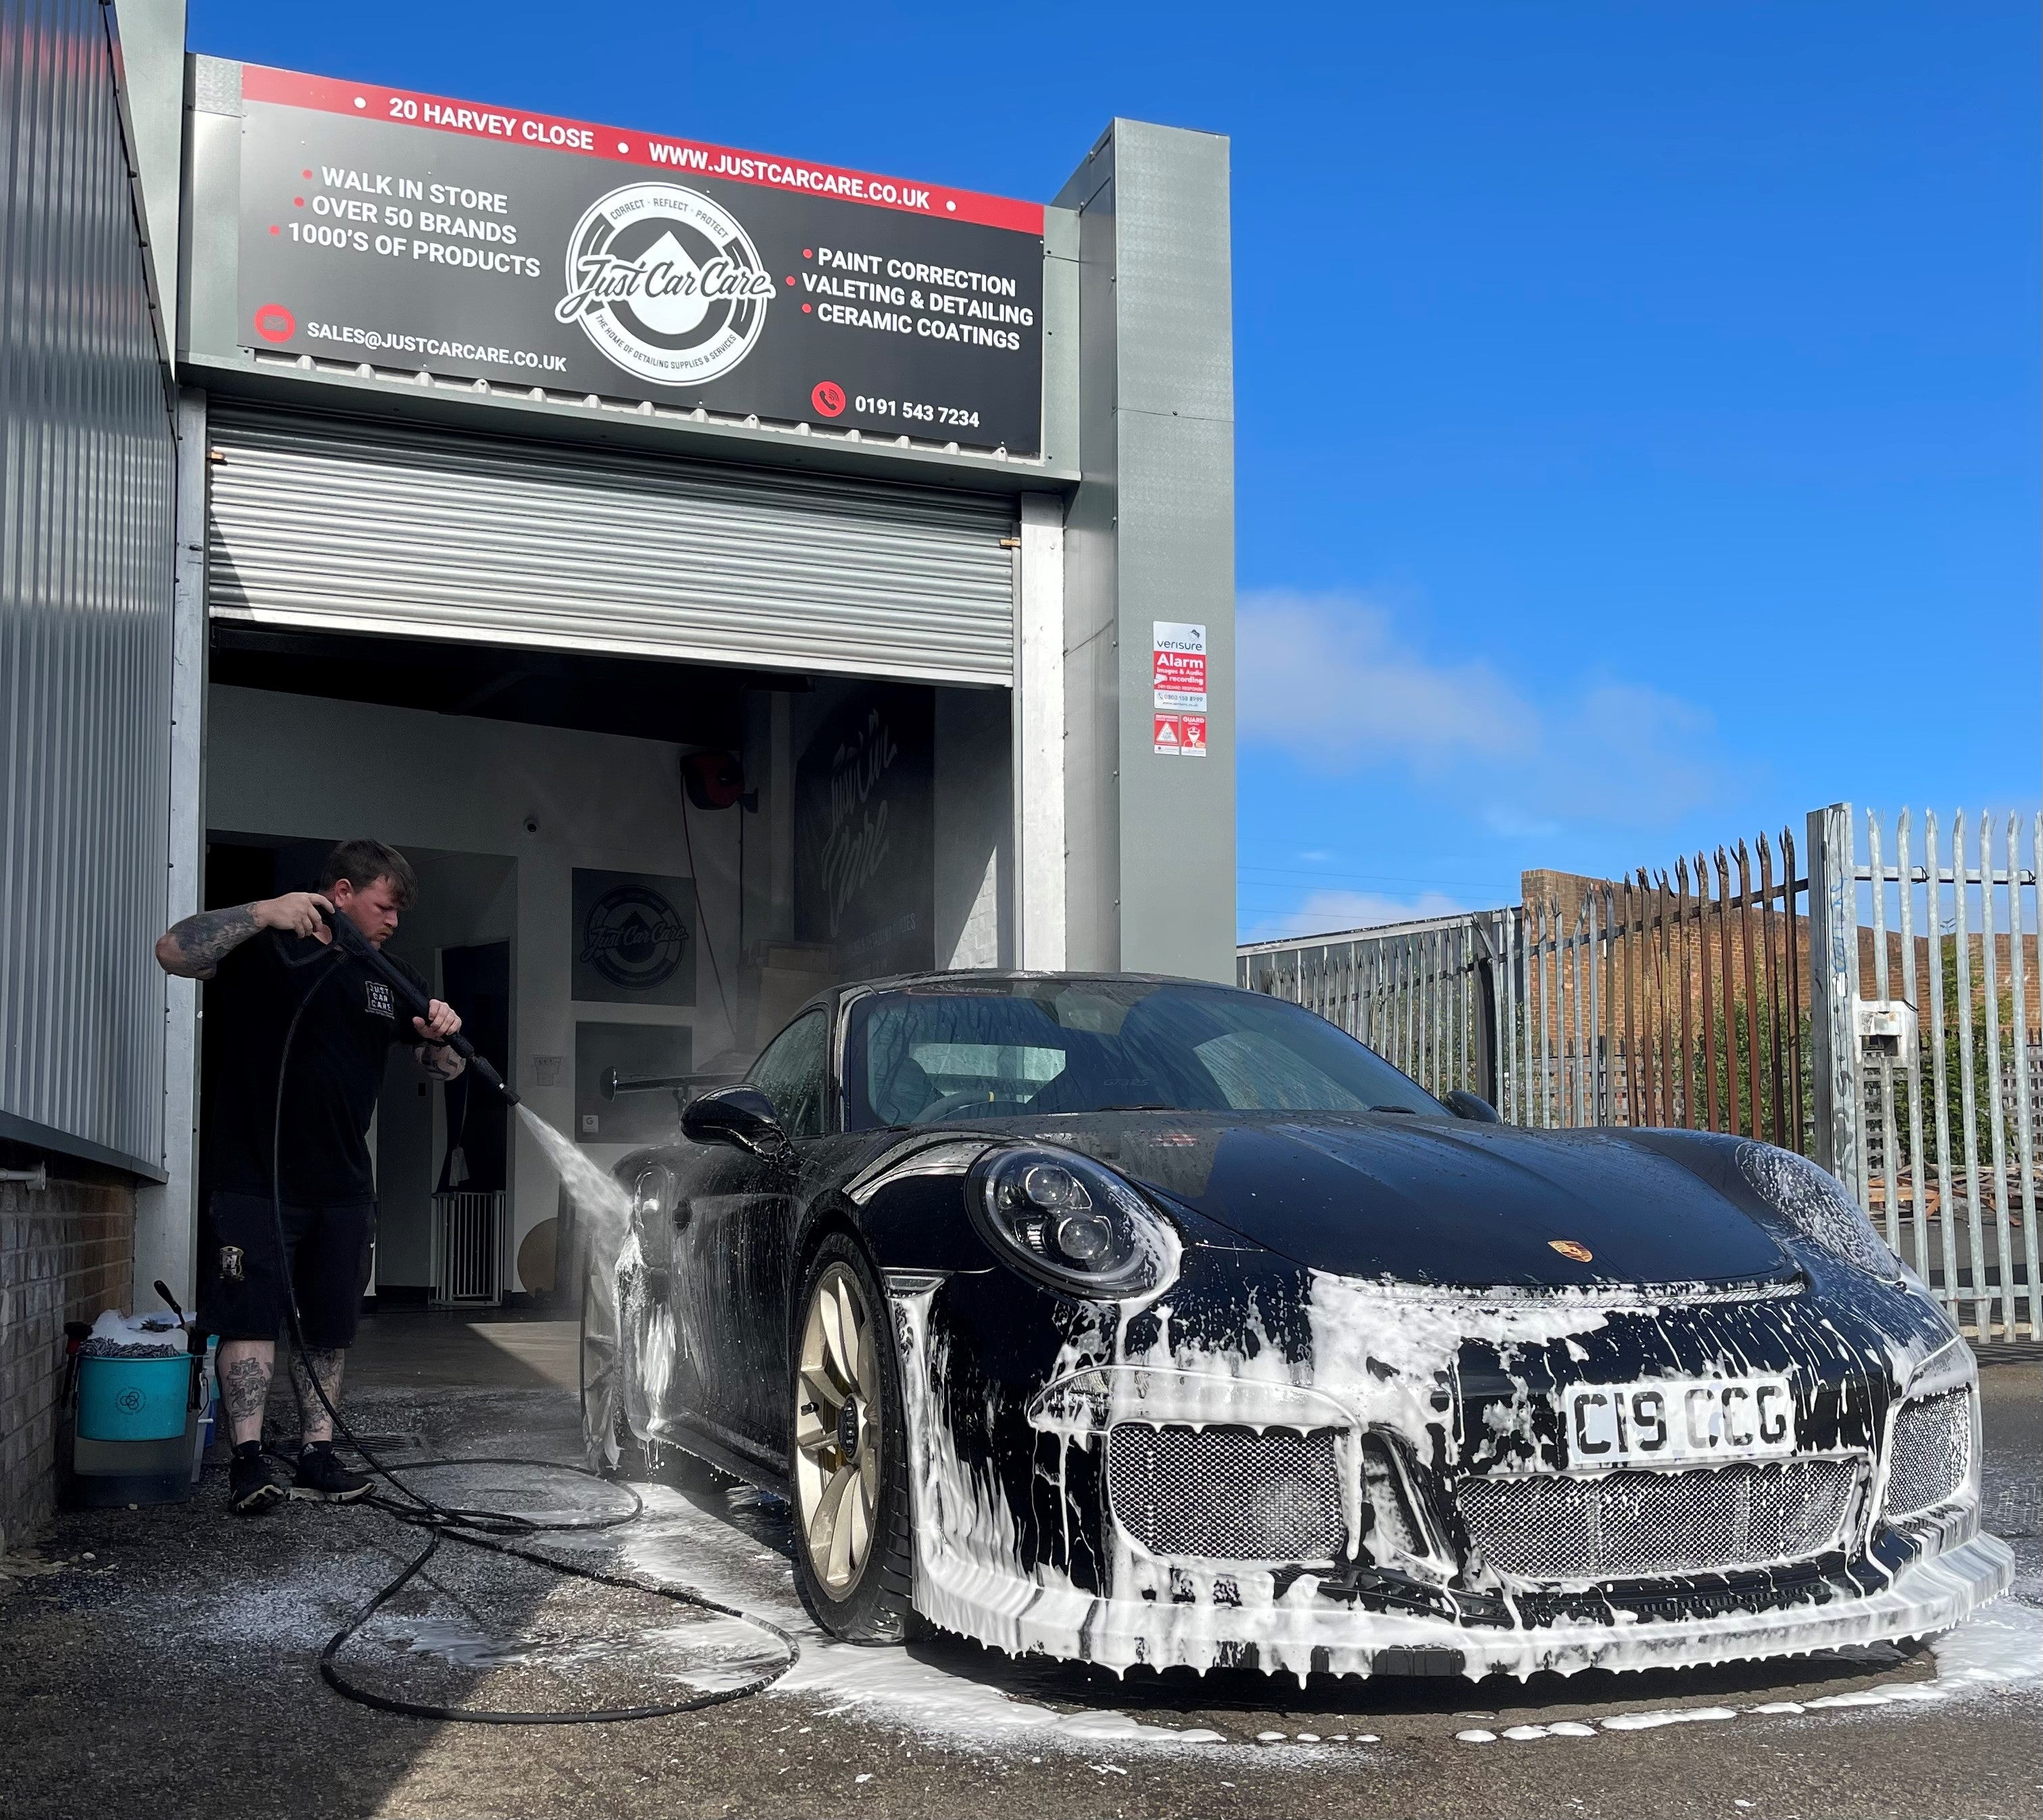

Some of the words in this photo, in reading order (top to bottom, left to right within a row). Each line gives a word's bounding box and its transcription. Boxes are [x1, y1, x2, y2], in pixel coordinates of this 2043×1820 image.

[389, 97, 418, 120] 20
[424, 103, 518, 137] HARVEY
[522, 120, 595, 151] CLOSE
[321, 166, 393, 196] WALK
[398, 178, 424, 201] IN
[429, 183, 508, 215] STORE
[648, 142, 931, 210] WWW.JUSTCARCARE.CO.UK
[312, 195, 378, 224] OVER
[384, 206, 413, 228] 50
[420, 212, 518, 245] BRANDS
[610, 199, 645, 220] CORRECT
[653, 198, 689, 212] REFLECT
[695, 210, 729, 238] PROTECT
[288, 222, 369, 252] 1000'S
[374, 235, 408, 257] OF
[413, 241, 541, 278] PRODUCTS
[818, 247, 883, 275] PAINT
[887, 259, 1016, 297] CORRECTION
[560, 259, 648, 318] Just
[645, 261, 698, 298] Car
[699, 260, 772, 297] Care
[802, 272, 905, 306] VALETING
[910, 291, 925, 310] &
[929, 293, 1034, 326] DETAILING
[307, 322, 567, 372] SALES@JUSTCARCARE.CO.UK
[595, 314, 609, 330] THE
[604, 327, 625, 347] HOME
[623, 344, 634, 353] OF
[633, 351, 668, 368] DETAILING
[670, 358, 704, 369] SUPPLIES
[709, 334, 737, 360] SERVICES
[818, 303, 912, 334] CERAMIC
[917, 318, 1020, 351] COATINGS
[855, 395, 896, 416] 0191
[902, 402, 934, 421] 543
[937, 407, 980, 428] 7234
[1156, 640, 1202, 651] verisure
[1156, 653, 1204, 669] Alarm
[1156, 666, 1178, 675] Images
[1168, 676, 1204, 686] recording
[1182, 716, 1205, 724] GUARD
